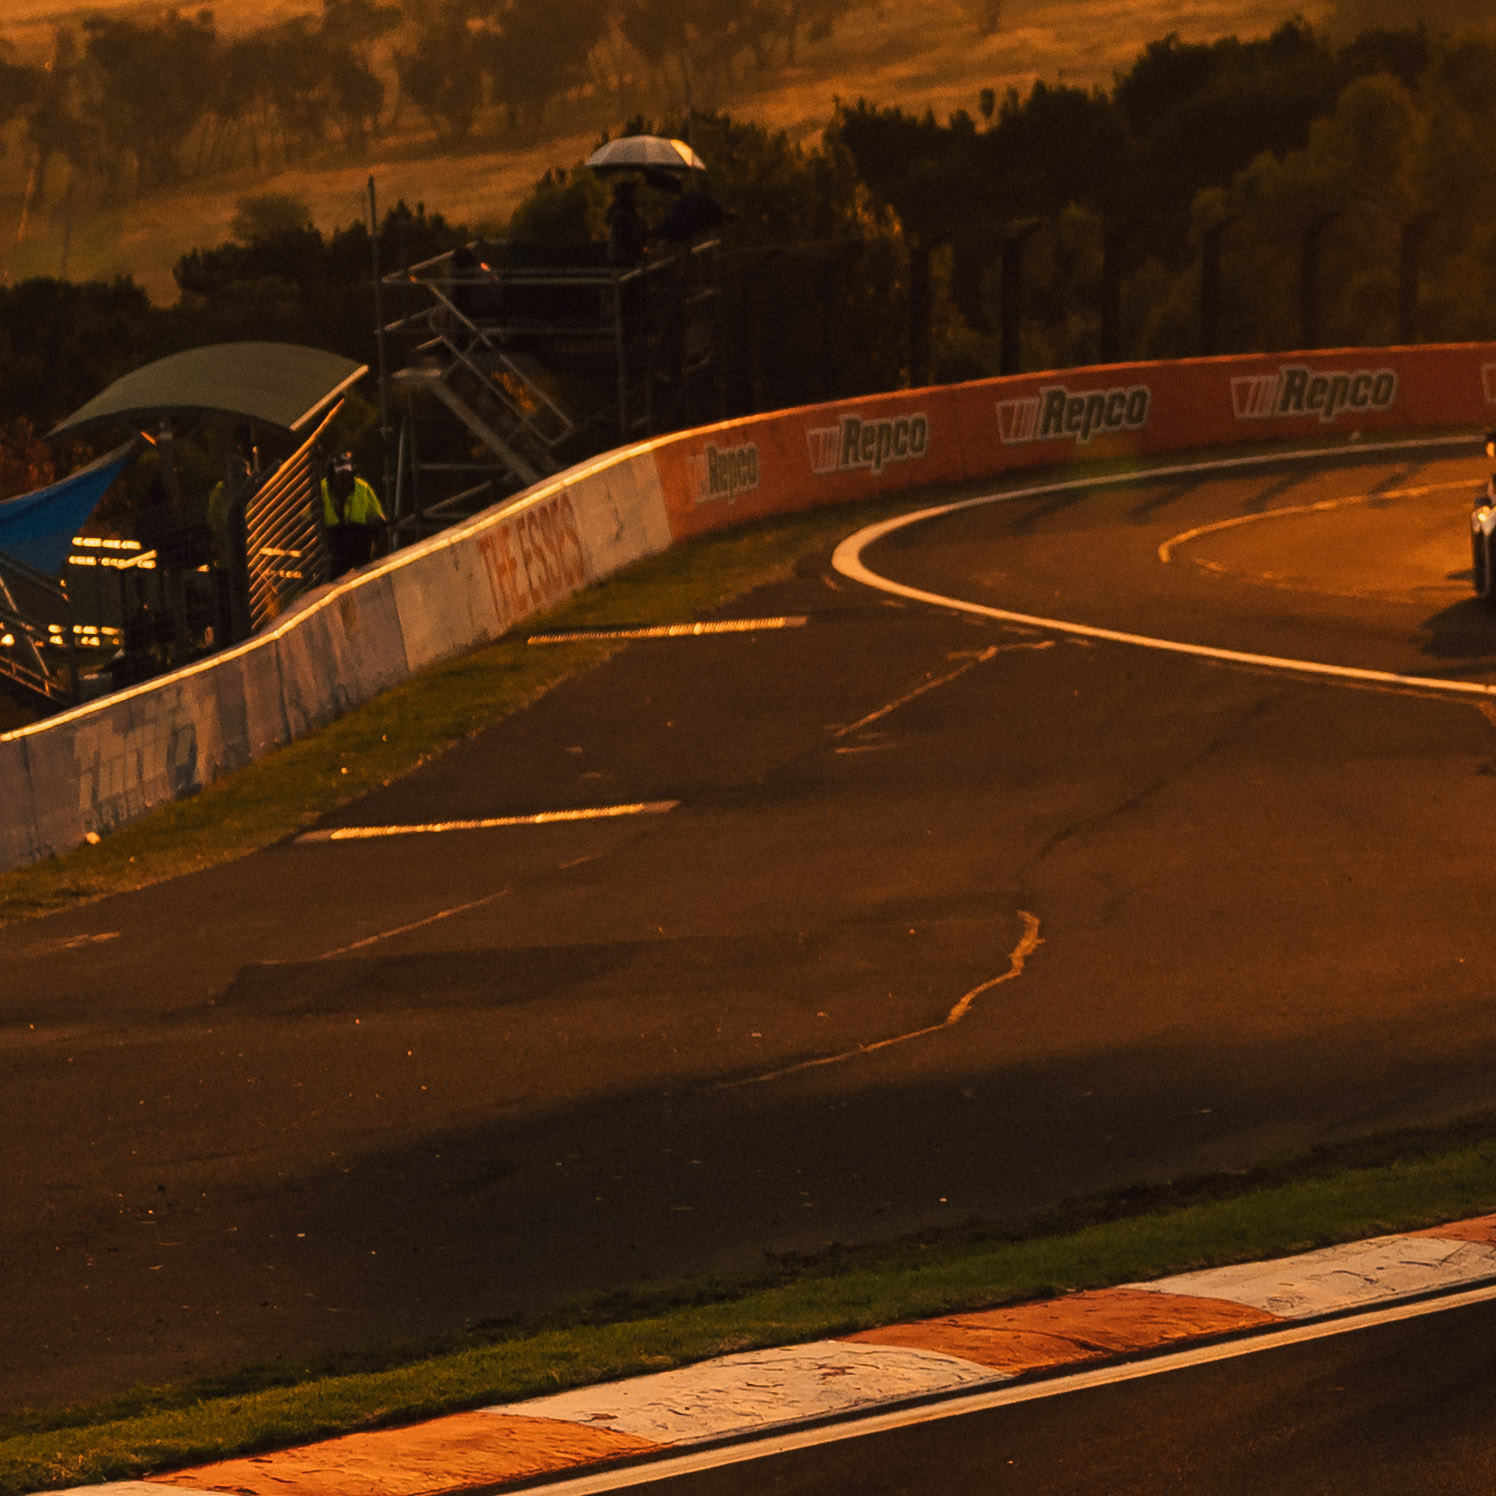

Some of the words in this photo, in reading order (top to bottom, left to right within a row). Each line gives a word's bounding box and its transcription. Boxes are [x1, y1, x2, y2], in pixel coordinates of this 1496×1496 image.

[1041, 389, 1148, 441] Repco
[1280, 370, 1396, 417] Repco
[841, 416, 927, 472] Repco
[707, 444, 759, 501] Repco
[475, 525, 528, 624] THE
